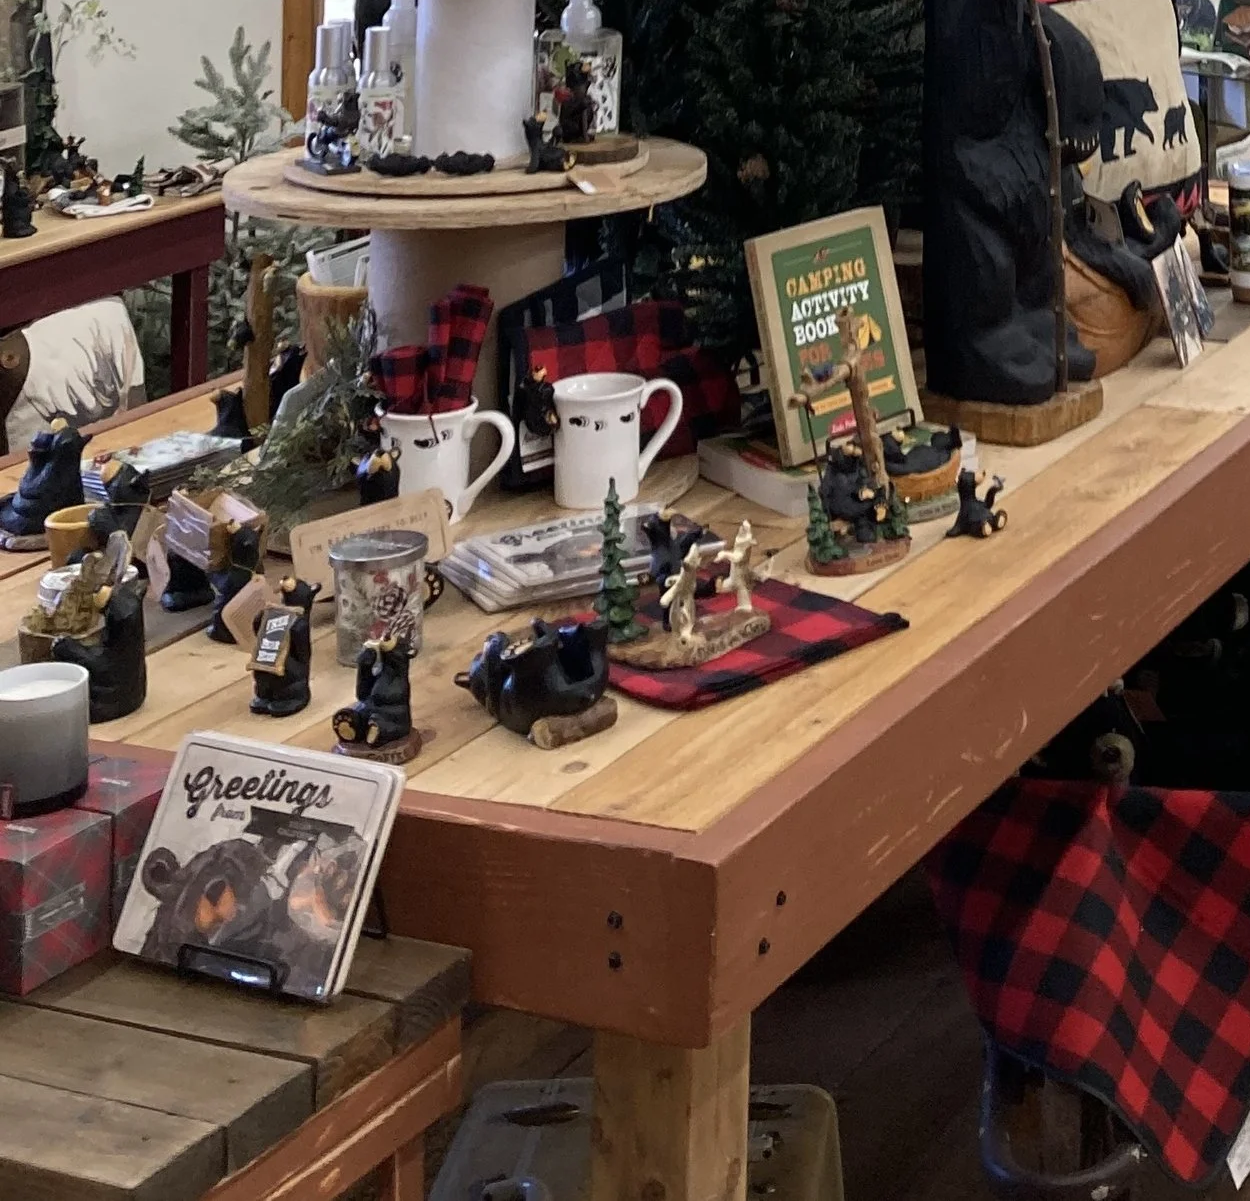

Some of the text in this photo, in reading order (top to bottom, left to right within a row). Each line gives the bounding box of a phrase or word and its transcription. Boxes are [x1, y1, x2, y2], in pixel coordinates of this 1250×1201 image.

[786, 257, 866, 298] CAMPING
[791, 279, 870, 323] ACTIVITY
[793, 314, 840, 346] BOOK
[183, 765, 334, 819] Greetings
